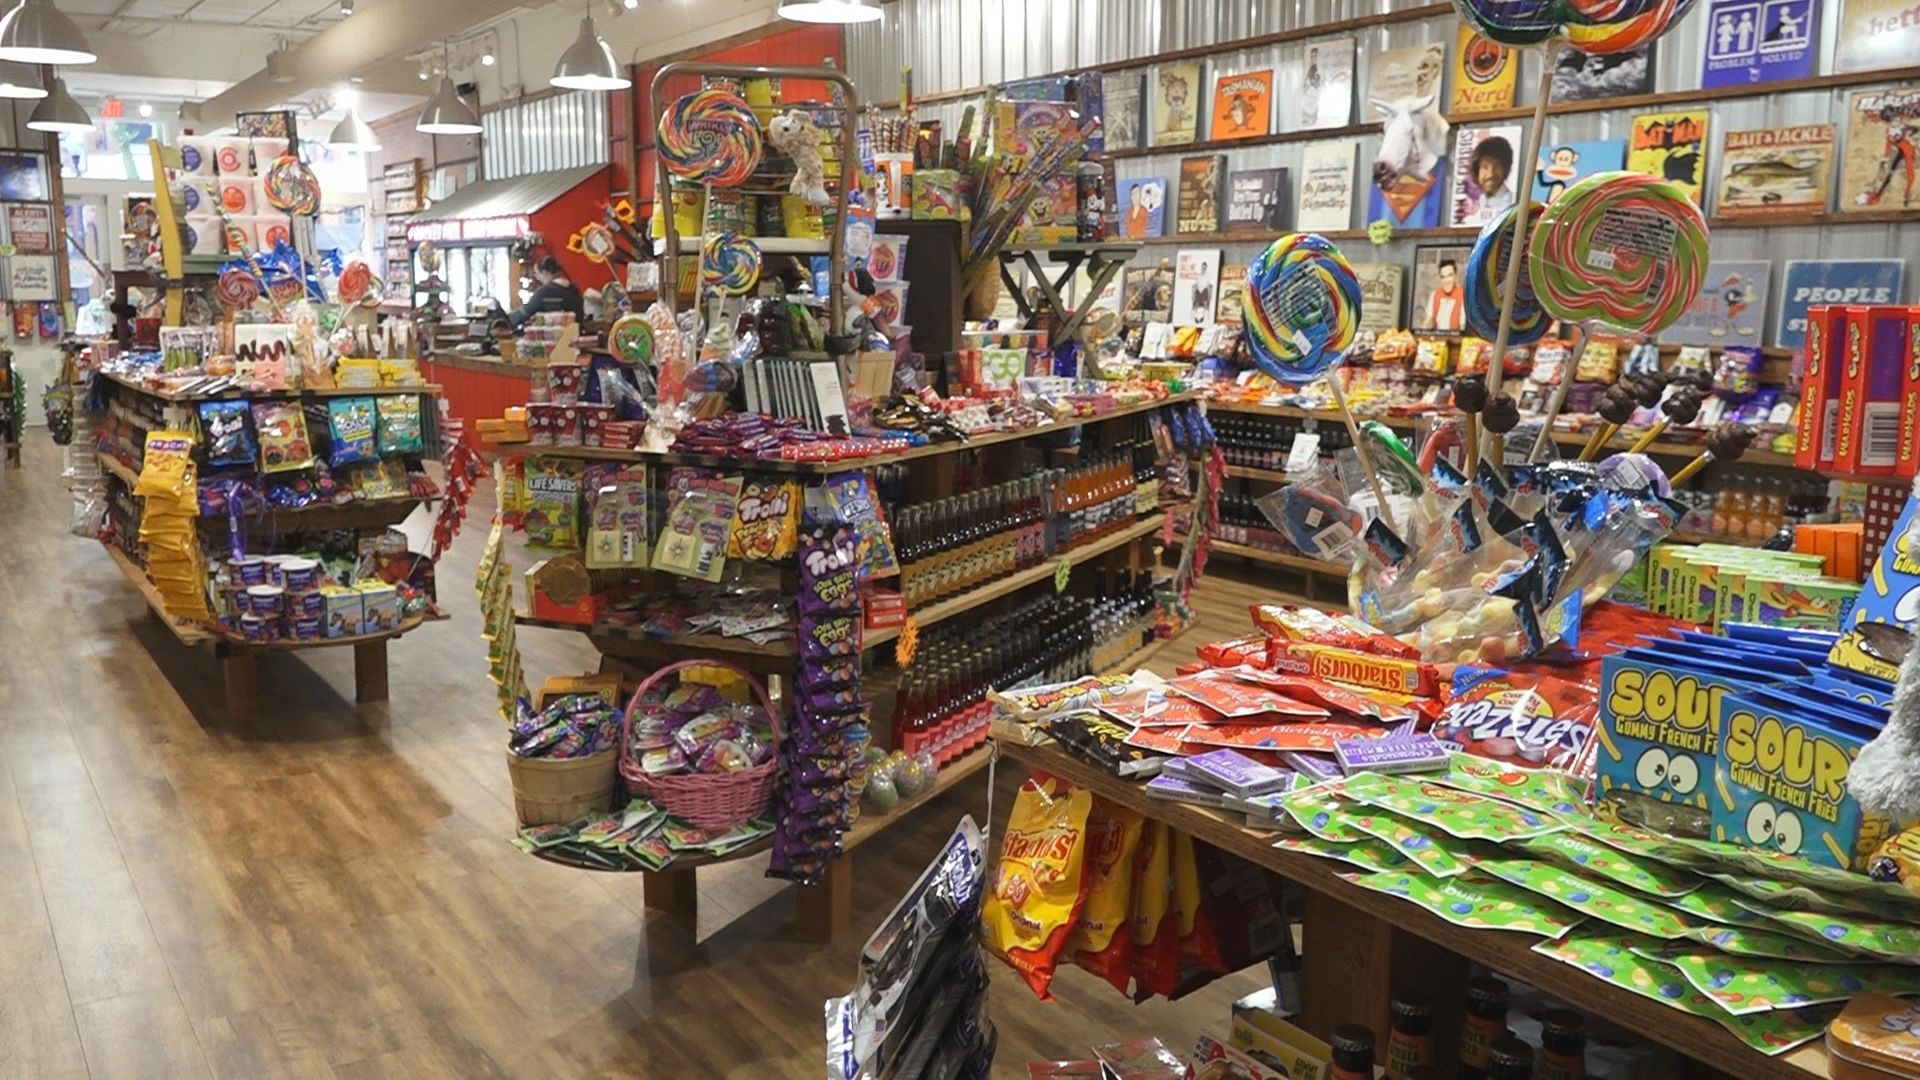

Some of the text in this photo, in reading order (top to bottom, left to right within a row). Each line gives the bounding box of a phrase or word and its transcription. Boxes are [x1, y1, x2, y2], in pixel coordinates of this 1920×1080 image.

[1708, 51, 1803, 70] PROBLEM SOLVED
[1455, 83, 1512, 106] Nerd
[1727, 130, 1763, 147] BAIT
[1771, 126, 1833, 145] TACKLE
[1178, 217, 1218, 233] NUTS
[1793, 287, 1891, 303] PEOPLE
[529, 478, 577, 492] LIFE SAVERS
[738, 492, 790, 525] Trolli
[1314, 656, 1402, 690] Starburst
[1615, 715, 1656, 740] GUMMY
[1659, 723, 1700, 754] FRENCH
[1725, 711, 1850, 804] SOUR
[1729, 761, 1765, 793] GUMMY
[1767, 773, 1806, 809] FRENCH
